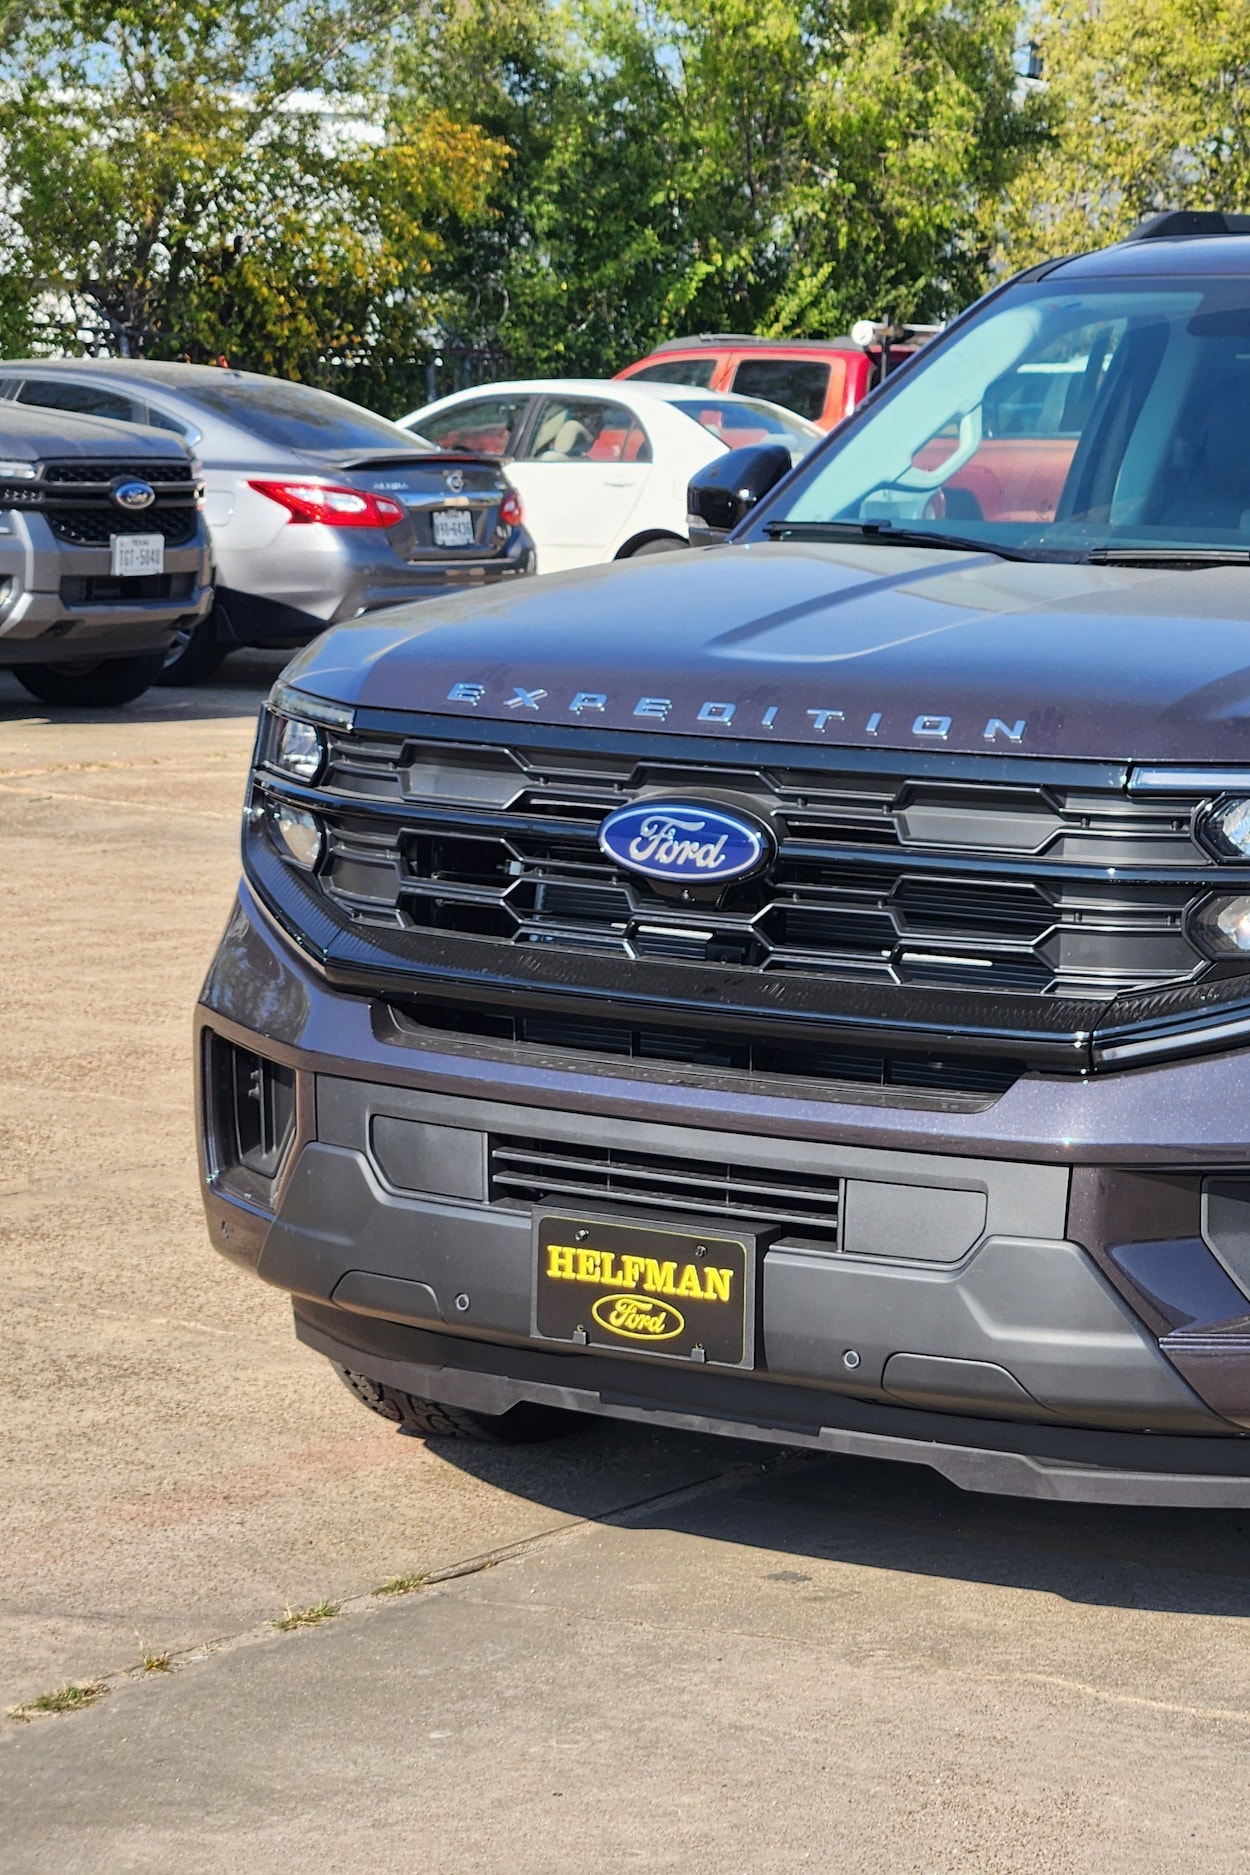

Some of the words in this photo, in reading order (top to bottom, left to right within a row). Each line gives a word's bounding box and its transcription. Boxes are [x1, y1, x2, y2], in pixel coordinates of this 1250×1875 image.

[447, 682, 1027, 741] EXPEDITION
[629, 815, 726, 870] Ford
[546, 1244, 734, 1302] HELFMAN
[608, 1298, 667, 1334] Ford
